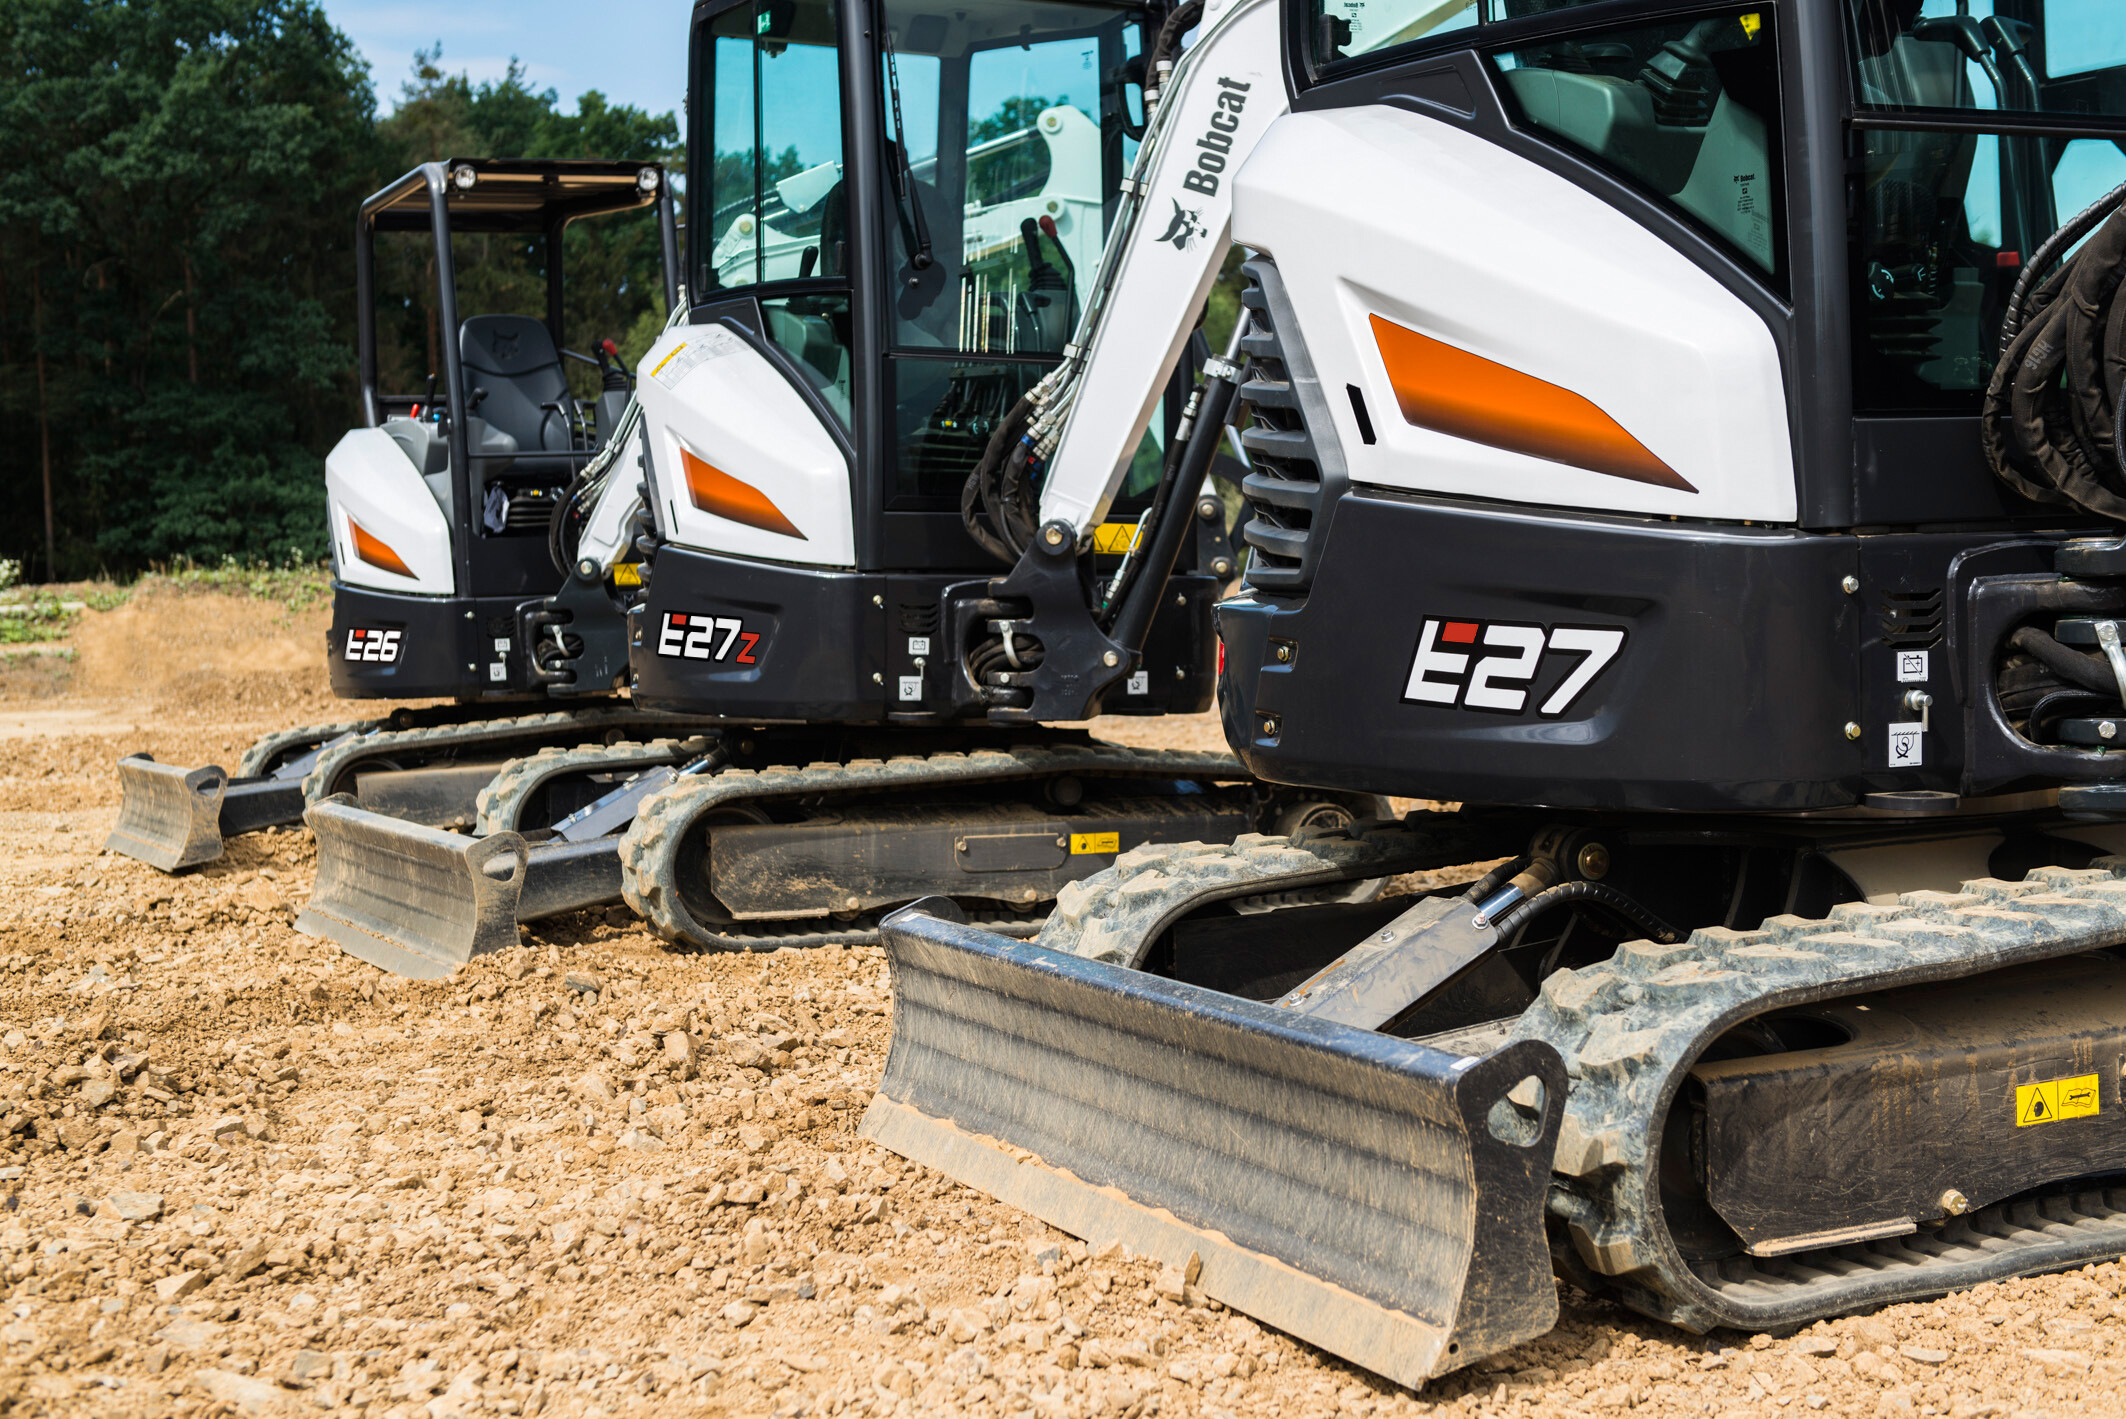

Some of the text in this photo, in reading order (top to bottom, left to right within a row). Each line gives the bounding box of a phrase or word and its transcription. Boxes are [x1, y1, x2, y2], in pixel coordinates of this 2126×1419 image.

[1183, 77, 1251, 197] Bobcat
[344, 628, 402, 662] E26
[1404, 619, 1625, 714] E27
